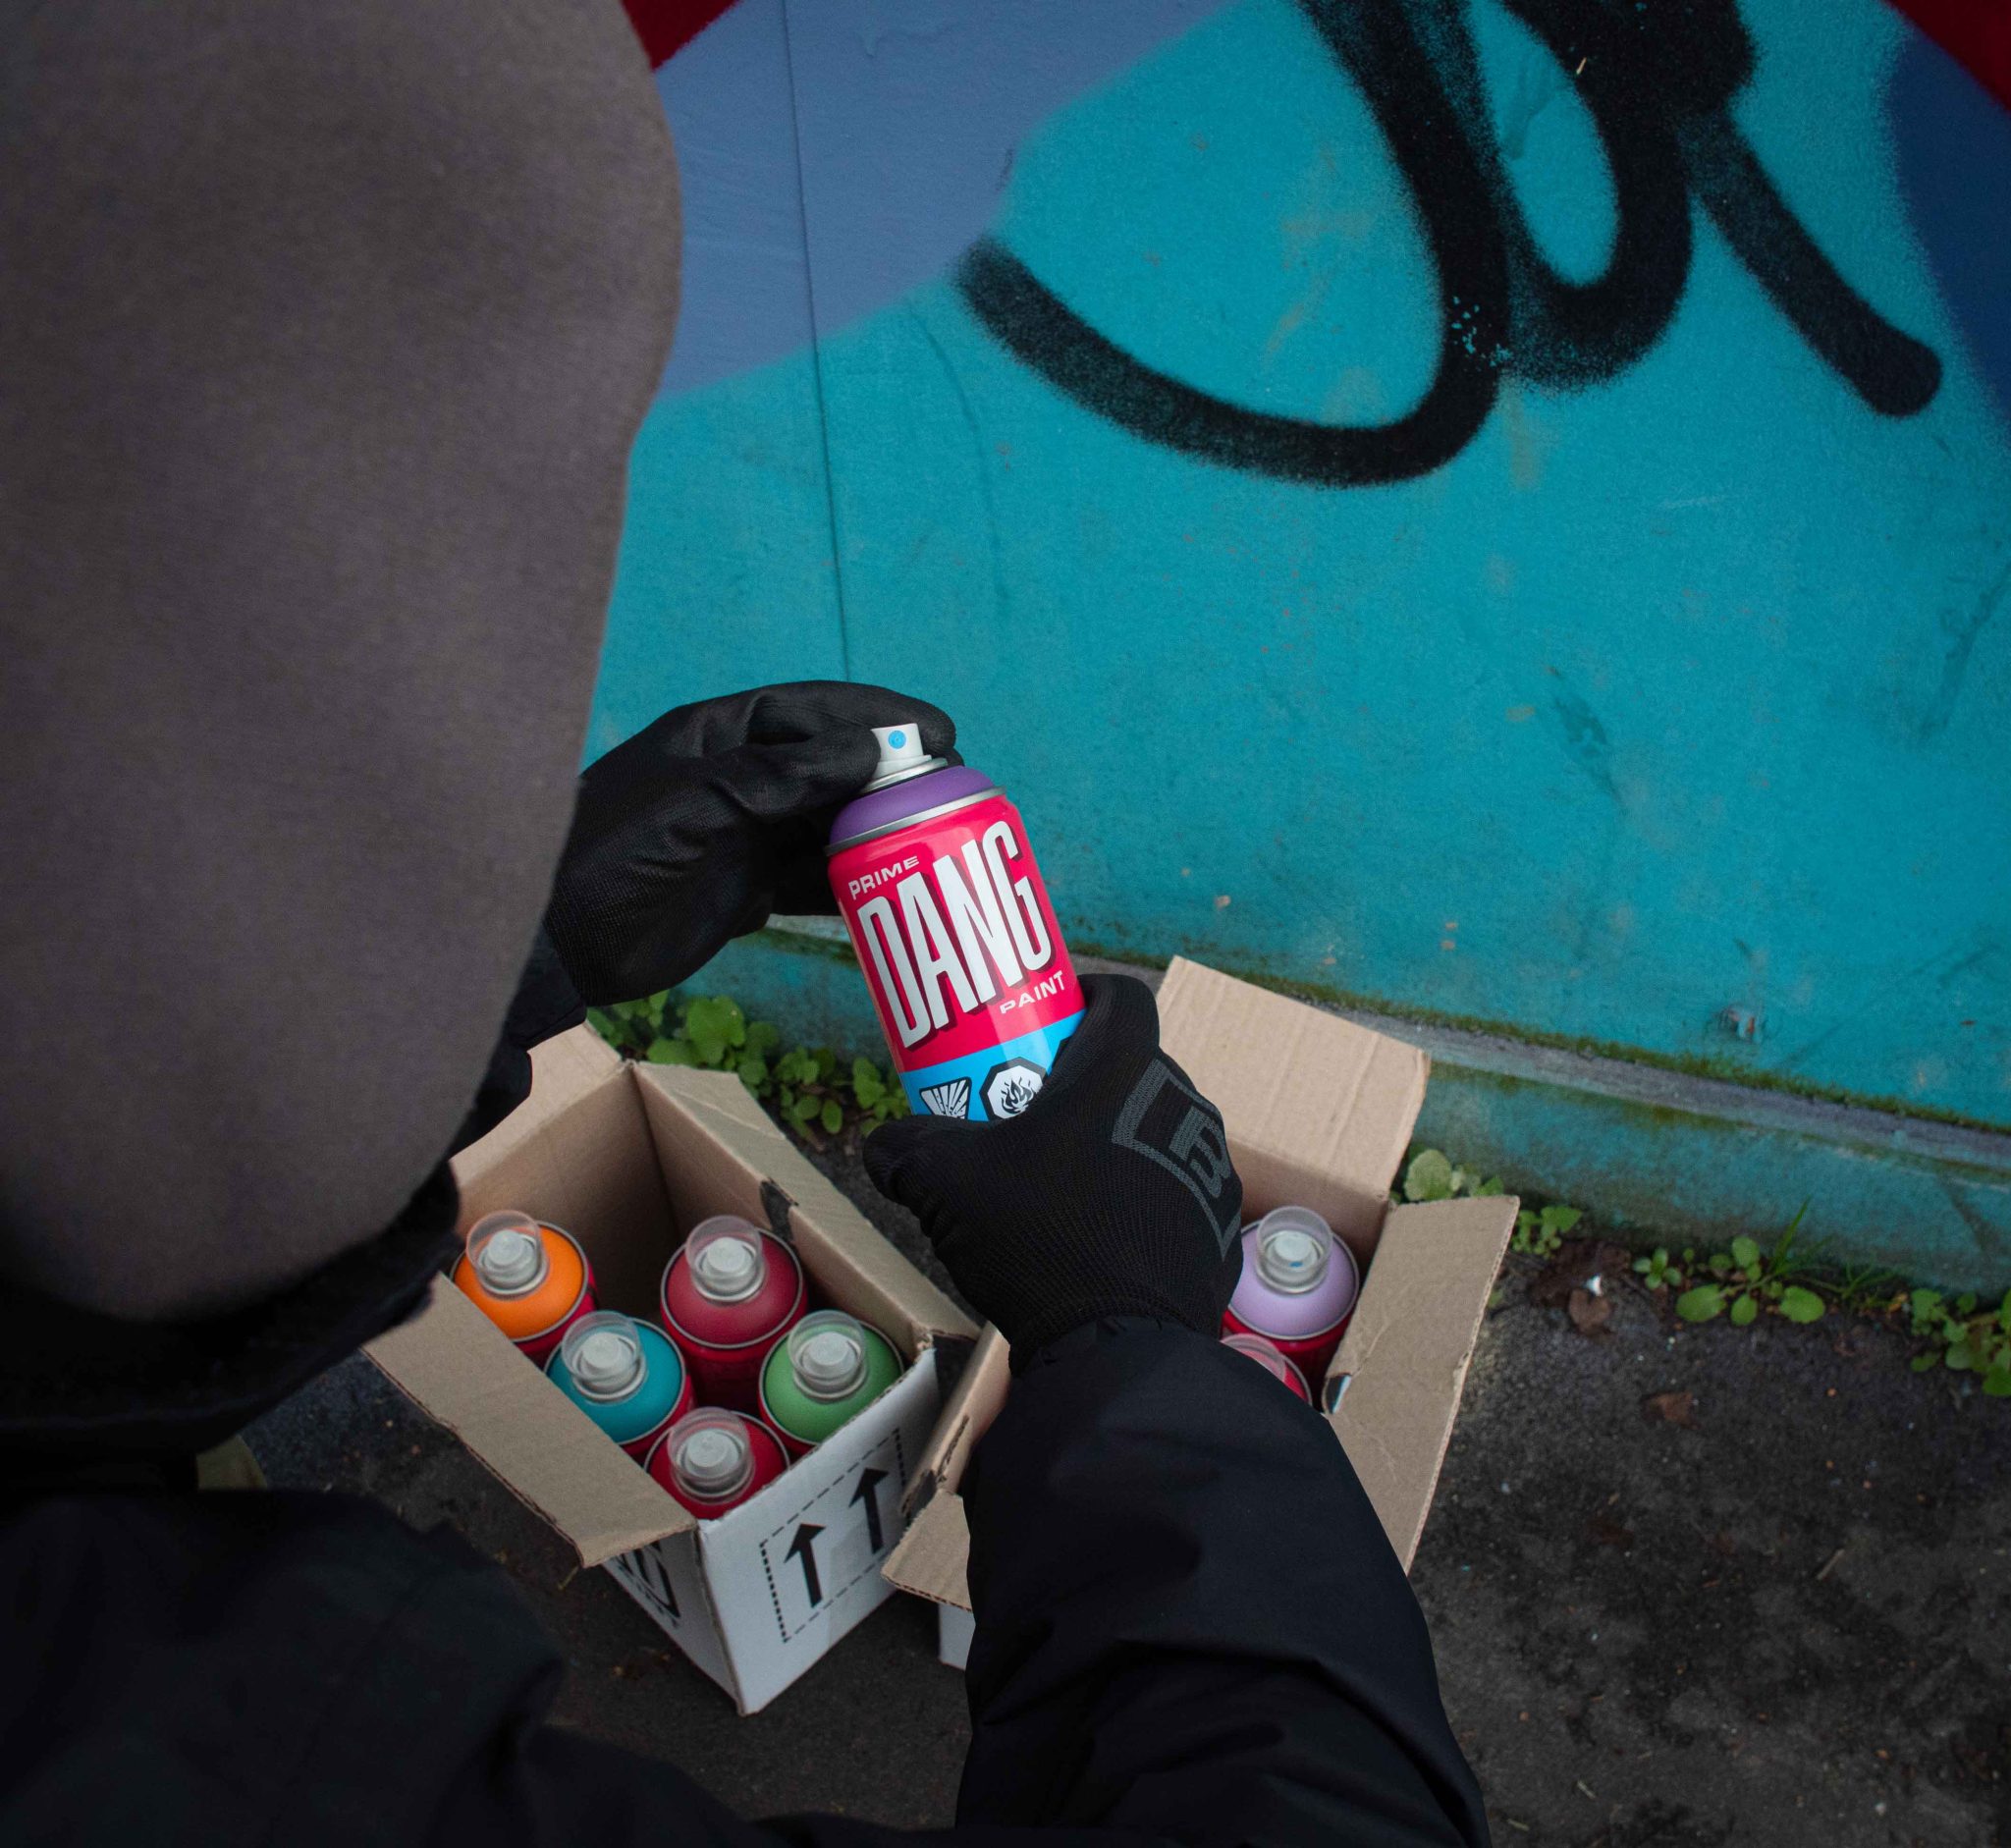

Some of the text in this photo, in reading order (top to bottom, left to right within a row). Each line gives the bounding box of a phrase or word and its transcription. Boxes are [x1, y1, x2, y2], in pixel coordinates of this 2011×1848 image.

[847, 855, 920, 901] PRIME
[857, 820, 1054, 1050] DANG
[999, 969, 1065, 1014] PAINT
